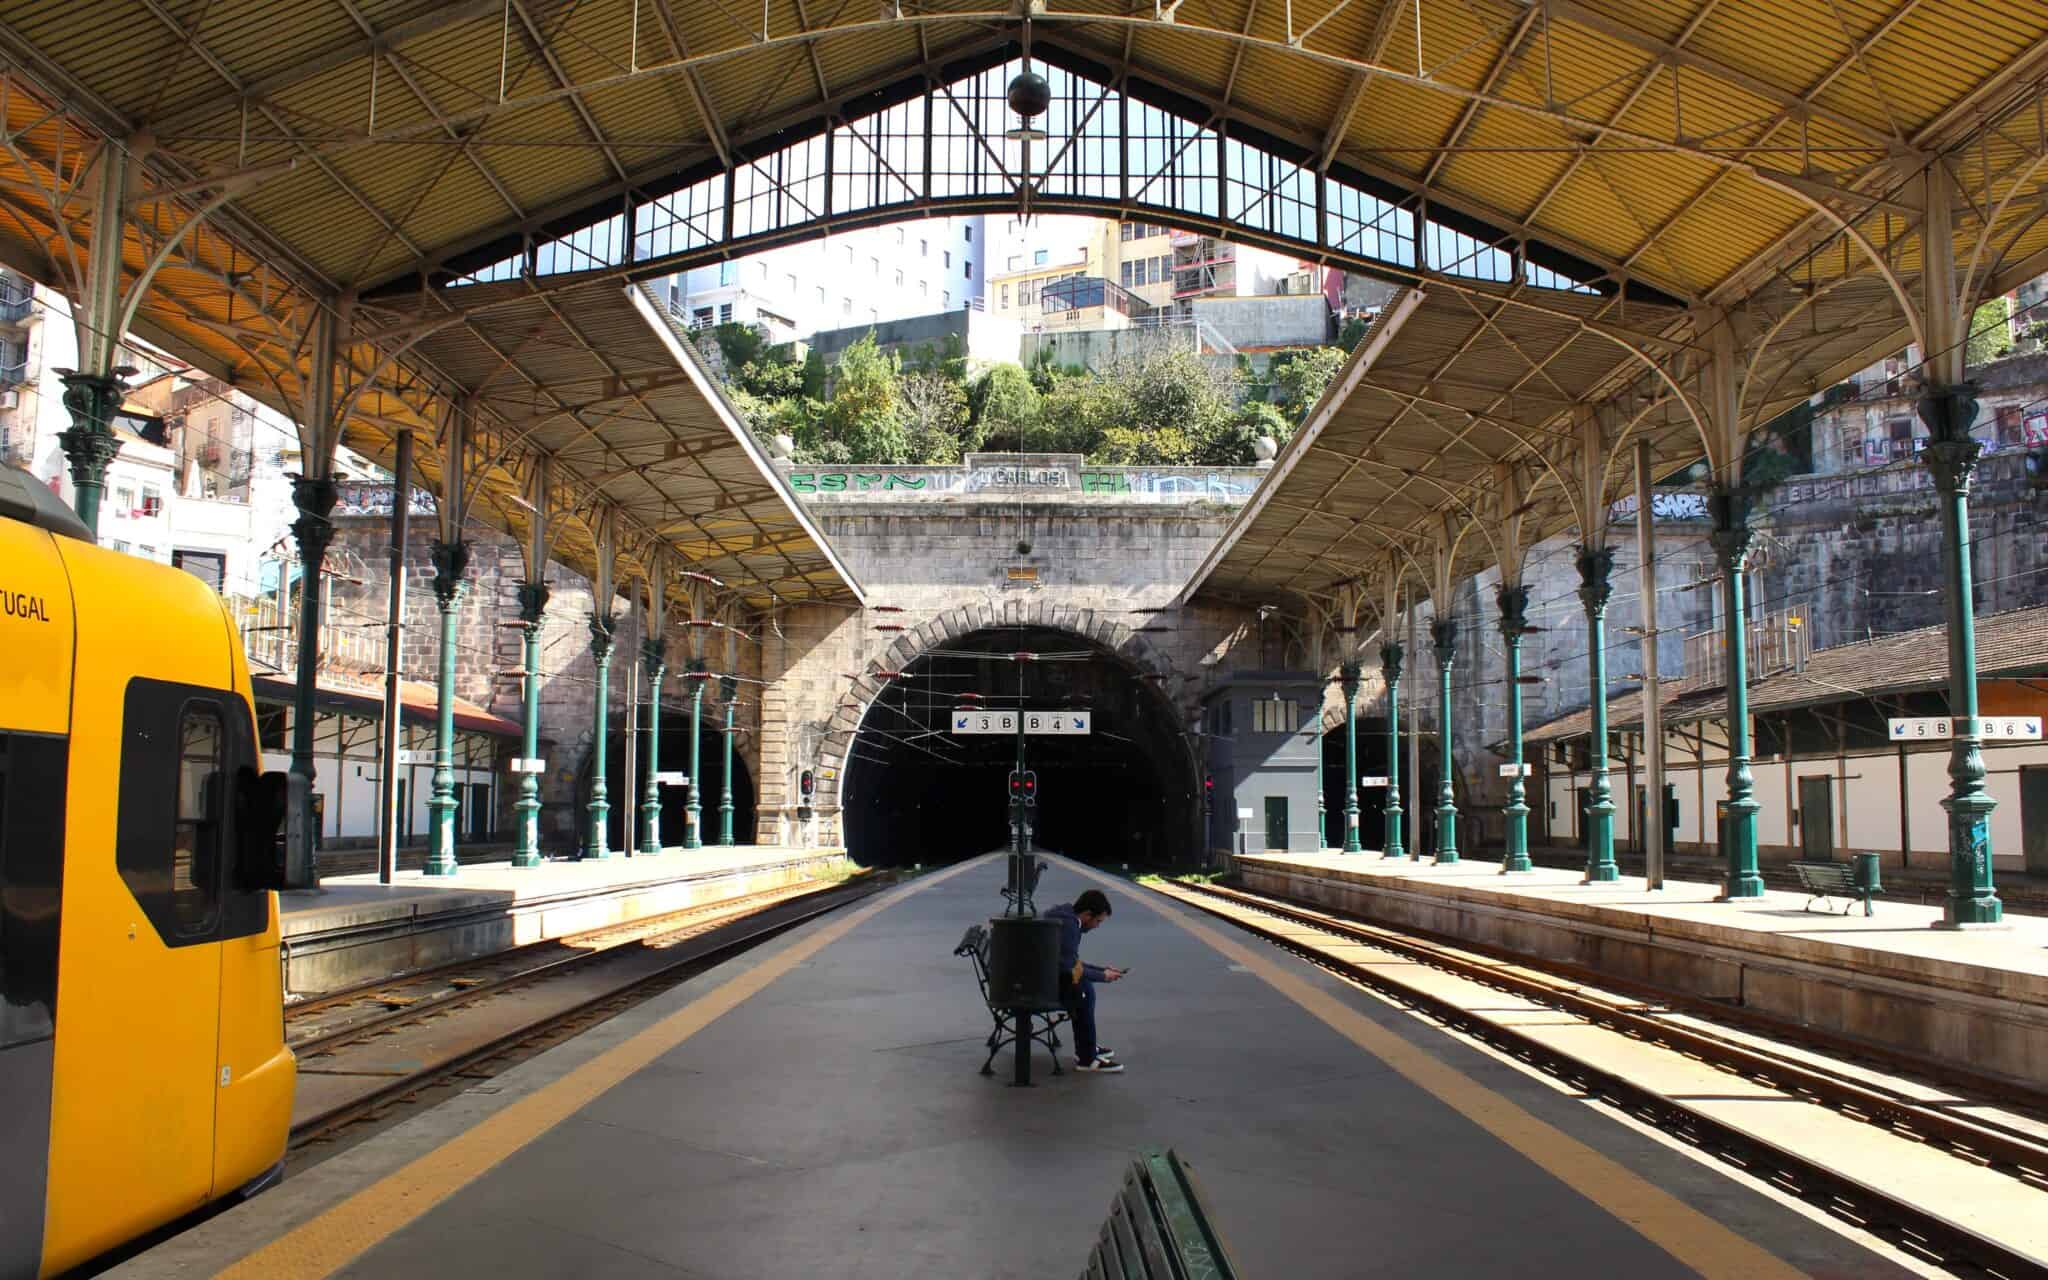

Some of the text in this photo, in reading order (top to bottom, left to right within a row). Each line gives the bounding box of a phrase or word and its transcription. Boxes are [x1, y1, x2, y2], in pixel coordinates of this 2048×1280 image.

[0, 589, 50, 622] UGAL
[981, 718, 1012, 729] 3 B
[1030, 718, 1061, 730] B 4
[1917, 723, 1946, 735] 5 B
[1985, 723, 1994, 733] B
[2006, 725, 2014, 735] 6
